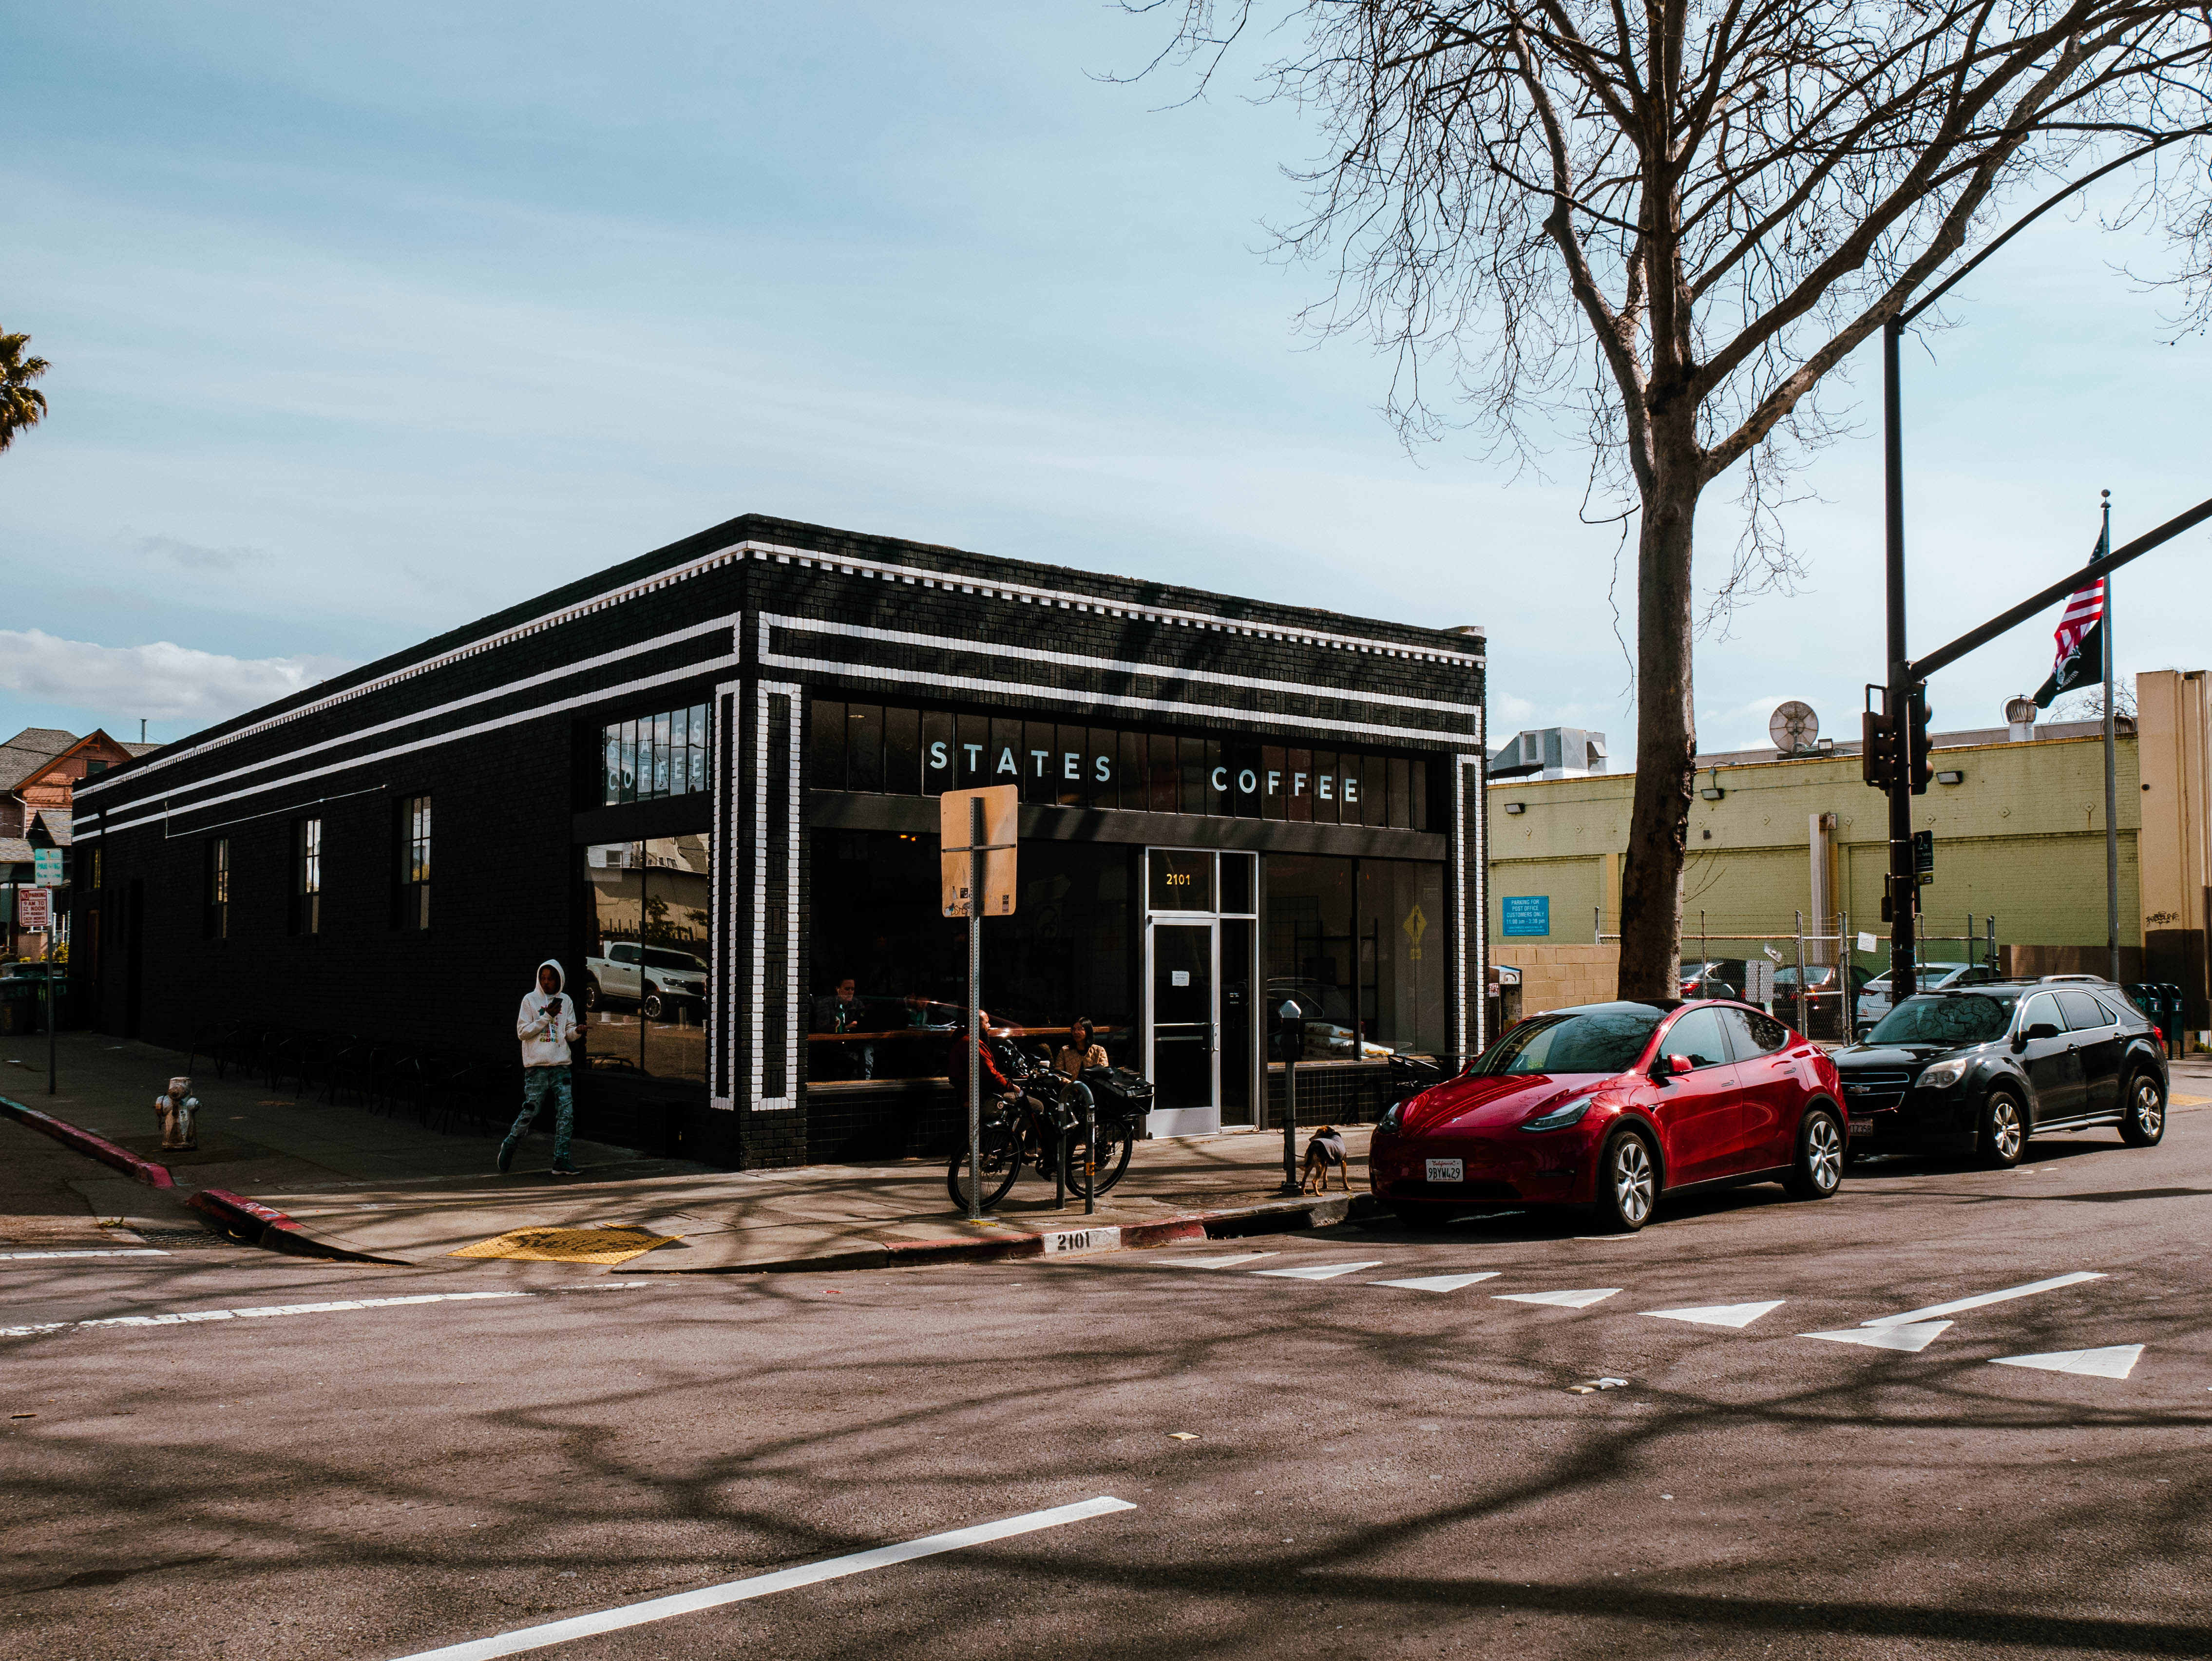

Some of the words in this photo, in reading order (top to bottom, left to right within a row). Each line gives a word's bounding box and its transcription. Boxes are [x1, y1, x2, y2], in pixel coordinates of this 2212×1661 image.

[609, 720, 701, 758] STATES
[609, 754, 701, 791] COFFEE
[930, 741, 1110, 782] STATES
[1212, 766, 1357, 802] COFFEE
[1918, 835, 1923, 850] 2
[1166, 874, 1190, 885] 2101
[21, 892, 29, 900] NO
[1429, 1167, 1460, 1178] 9BYW429
[1058, 1231, 1090, 1250] 2101
